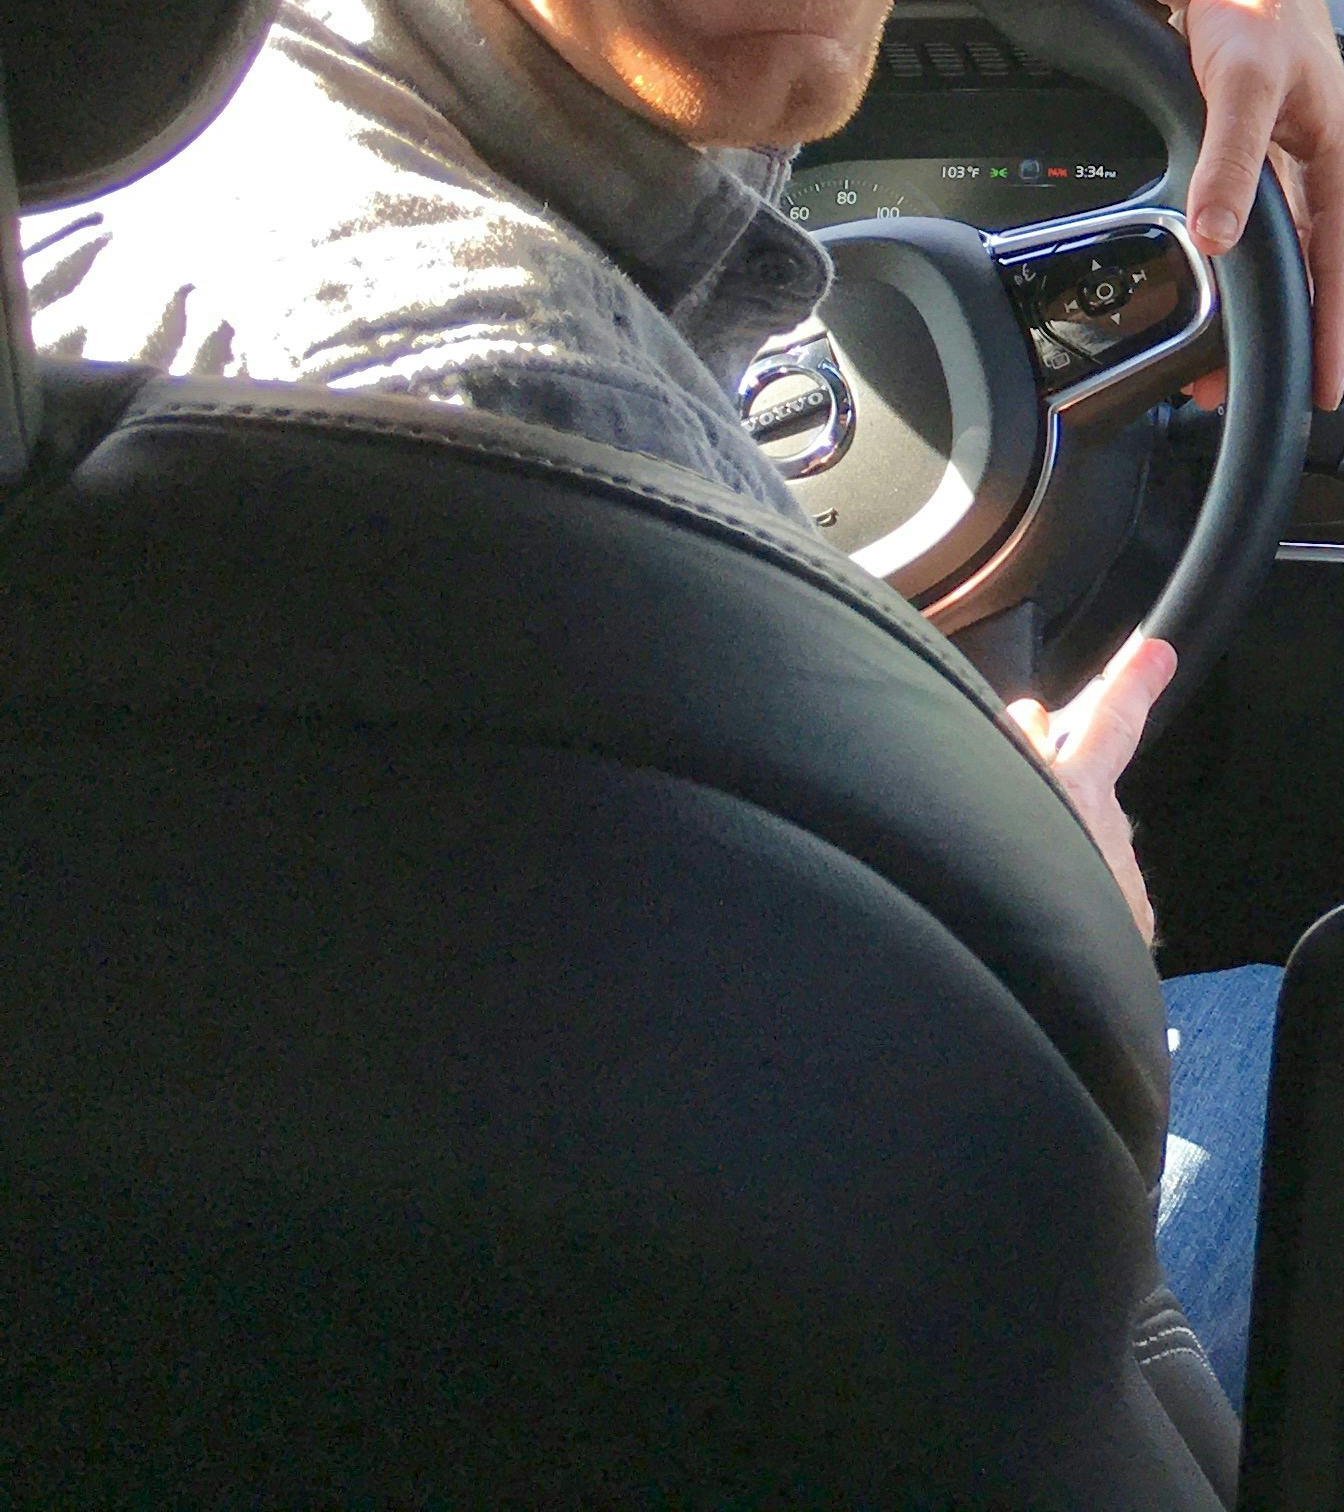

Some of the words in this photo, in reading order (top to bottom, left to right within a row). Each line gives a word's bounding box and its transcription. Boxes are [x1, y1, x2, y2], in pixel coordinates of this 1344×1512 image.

[836, 191, 857, 205] 80
[789, 206, 810, 220] 60
[876, 206, 900, 220] 100
[740, 391, 824, 433] VOLVO
